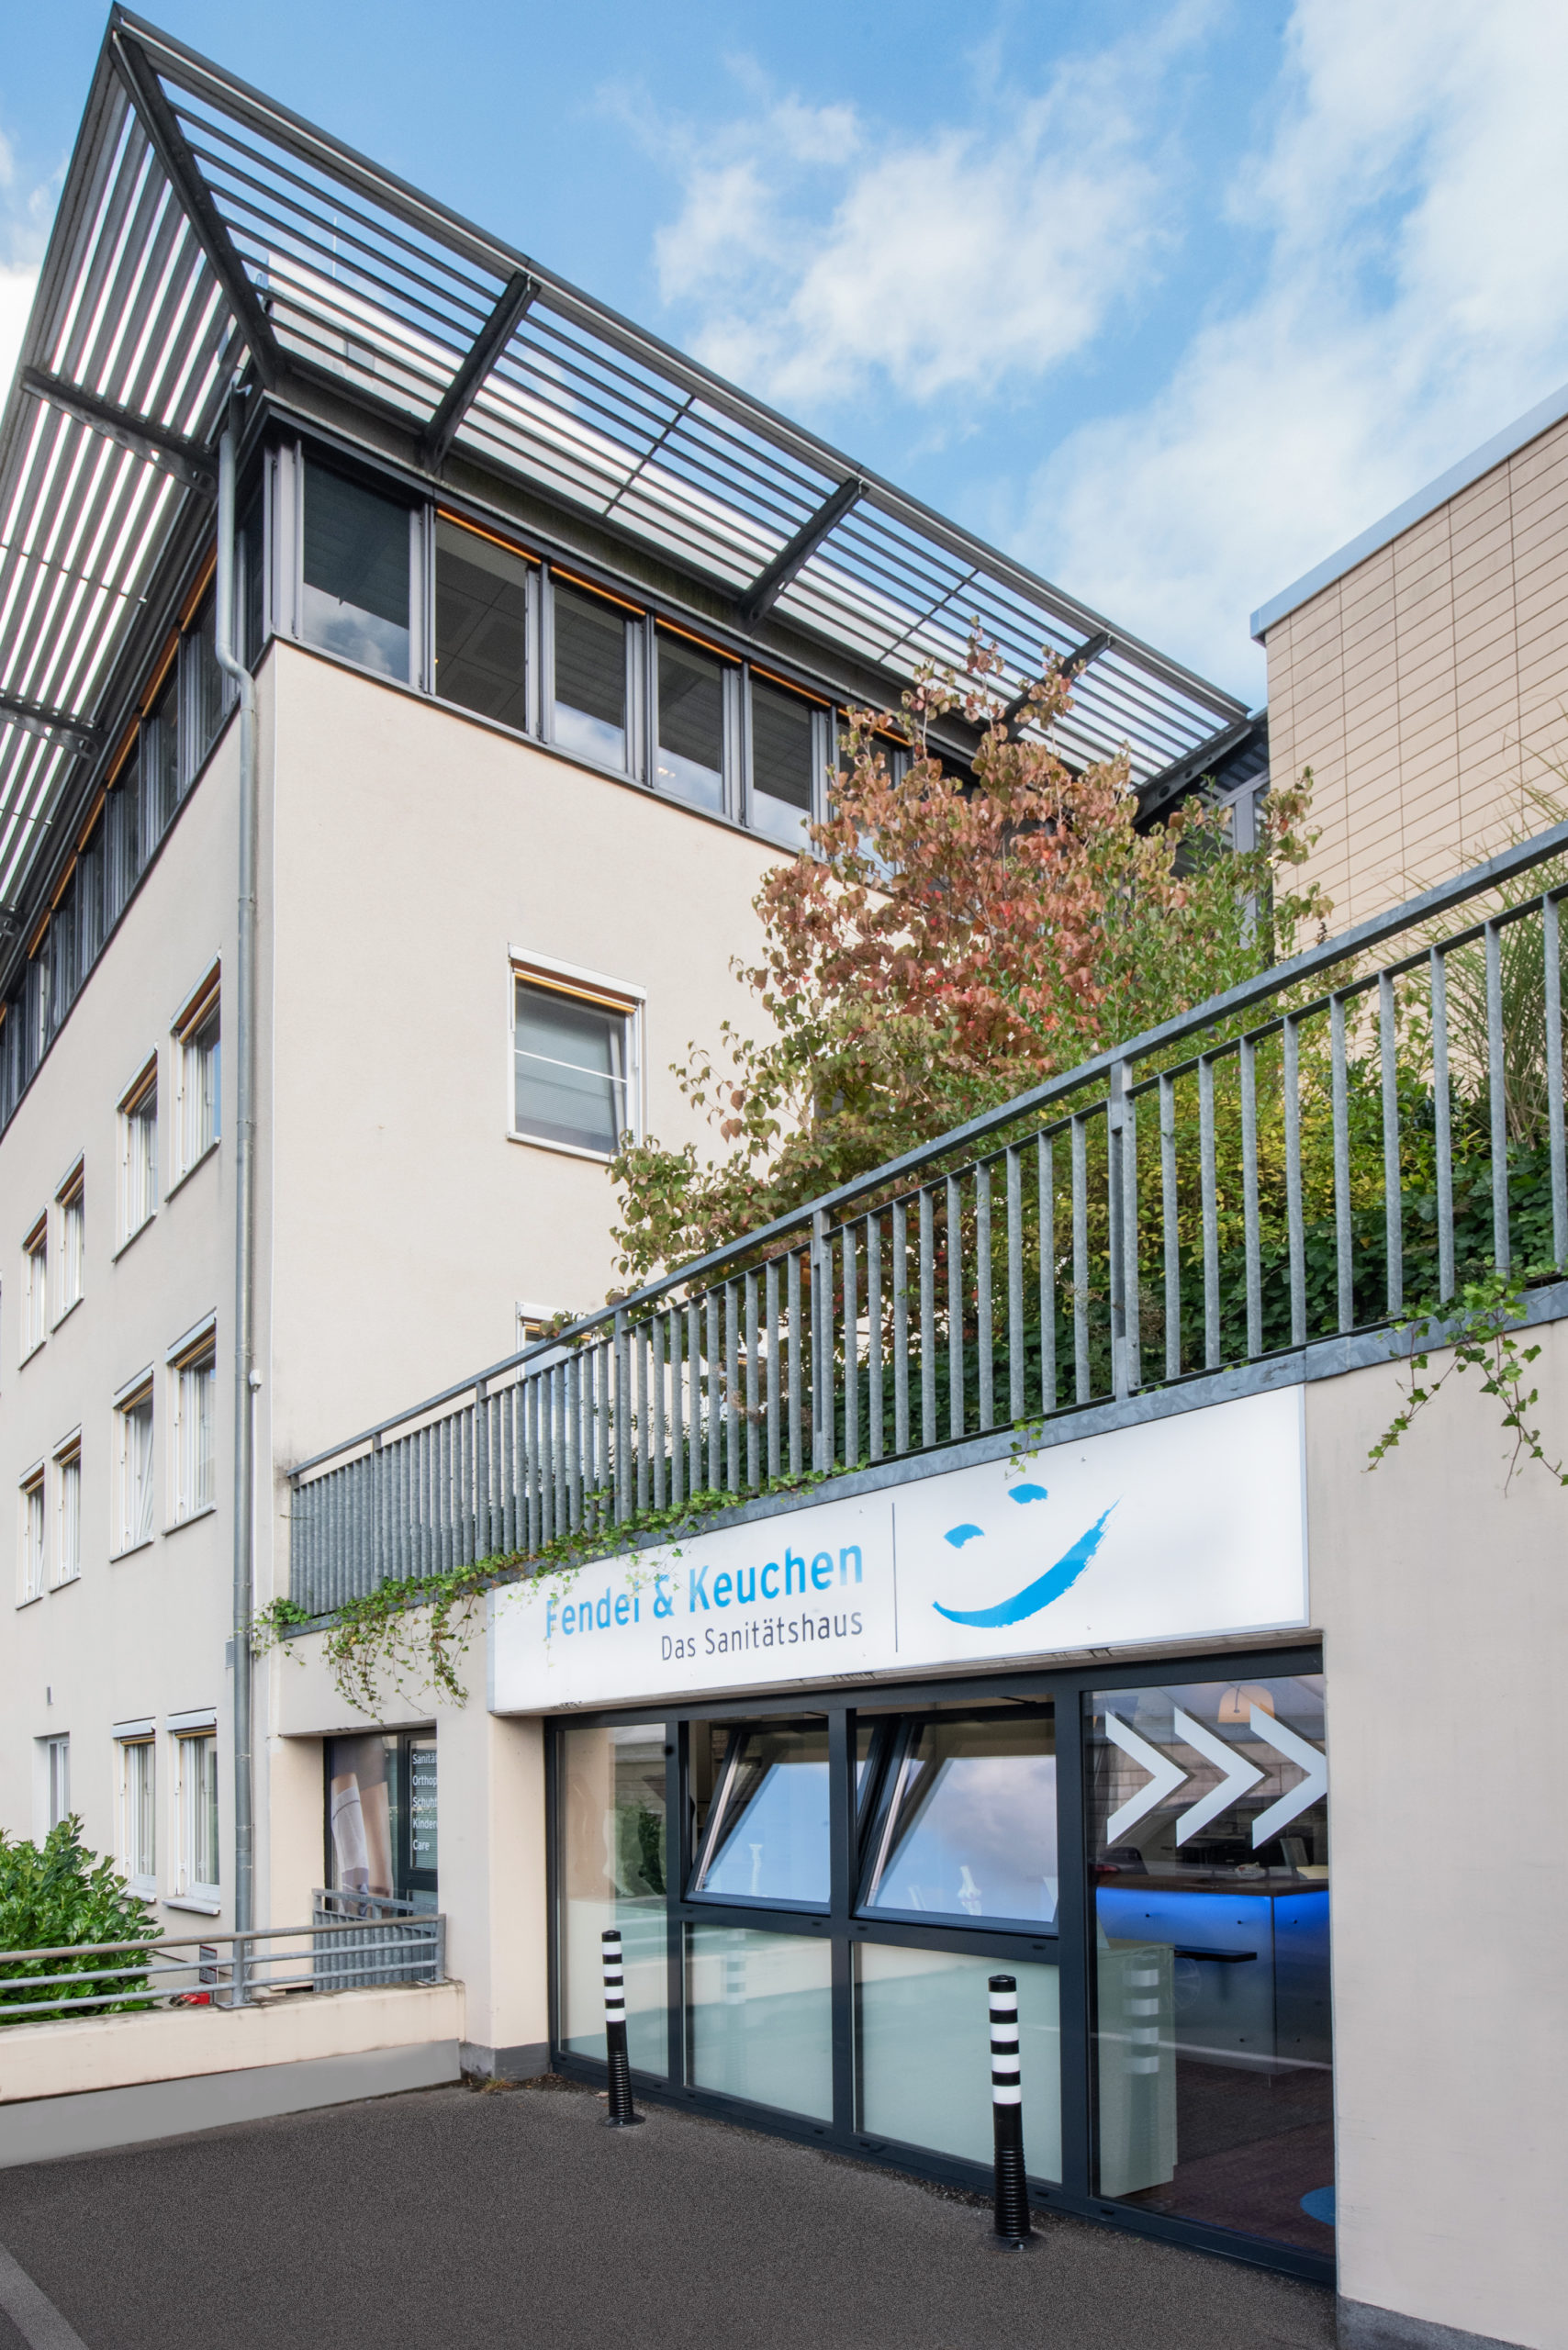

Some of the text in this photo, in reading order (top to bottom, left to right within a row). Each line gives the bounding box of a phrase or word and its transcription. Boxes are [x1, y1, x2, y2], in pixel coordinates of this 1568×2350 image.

[653, 1573, 675, 1619] &
[689, 1544, 863, 1614] Keuchen
[662, 1611, 863, 1661] Das Sanitätshaus
[412, 1839, 430, 1851] Care
